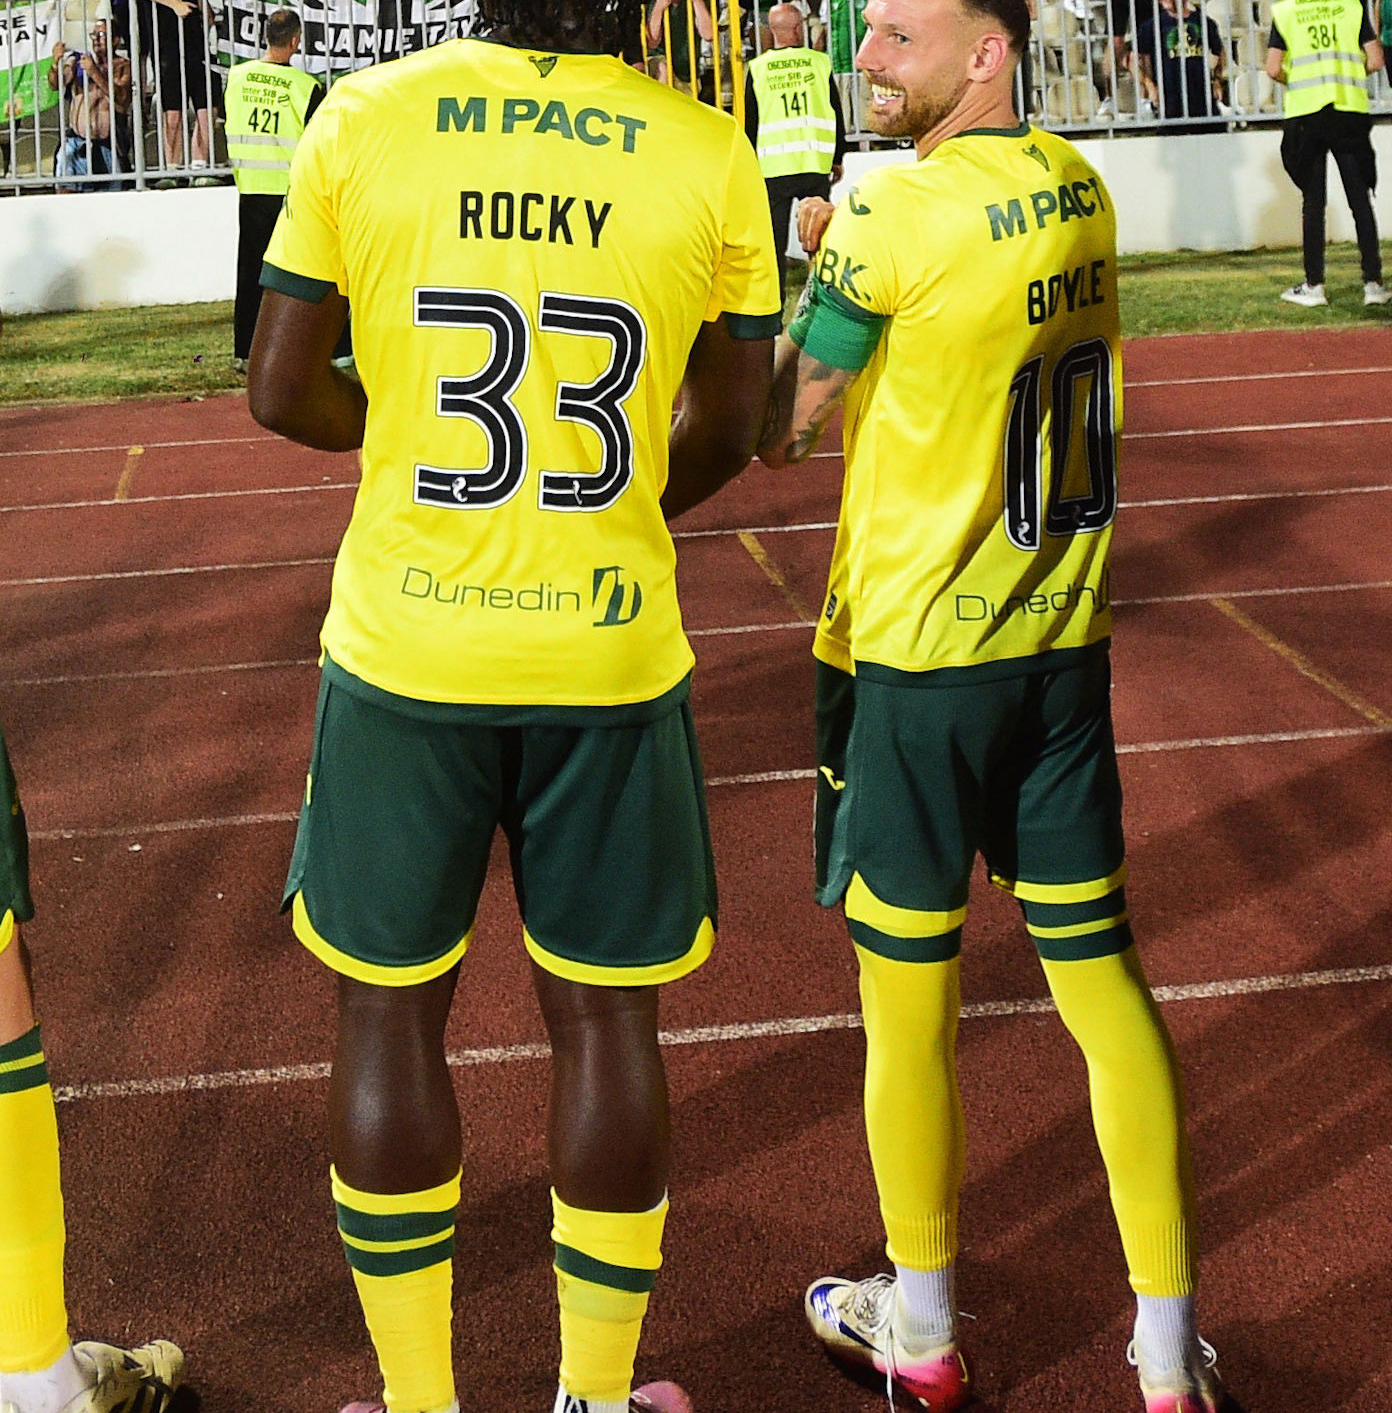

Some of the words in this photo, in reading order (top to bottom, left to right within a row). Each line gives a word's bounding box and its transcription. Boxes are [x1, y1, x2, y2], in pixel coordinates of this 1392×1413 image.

[314, 28, 415, 56] JAMIE
[248, 106, 280, 135] 421
[501, 98, 647, 154] PACT
[781, 91, 808, 118] 141
[460, 190, 613, 249] ROCKY
[1029, 177, 1105, 230] PACT
[1028, 259, 1106, 326] BOYLE
[413, 287, 648, 513] 33
[1003, 336, 1118, 552] 10
[401, 566, 581, 613] Dunedin
[956, 583, 1096, 621] Dunedn
